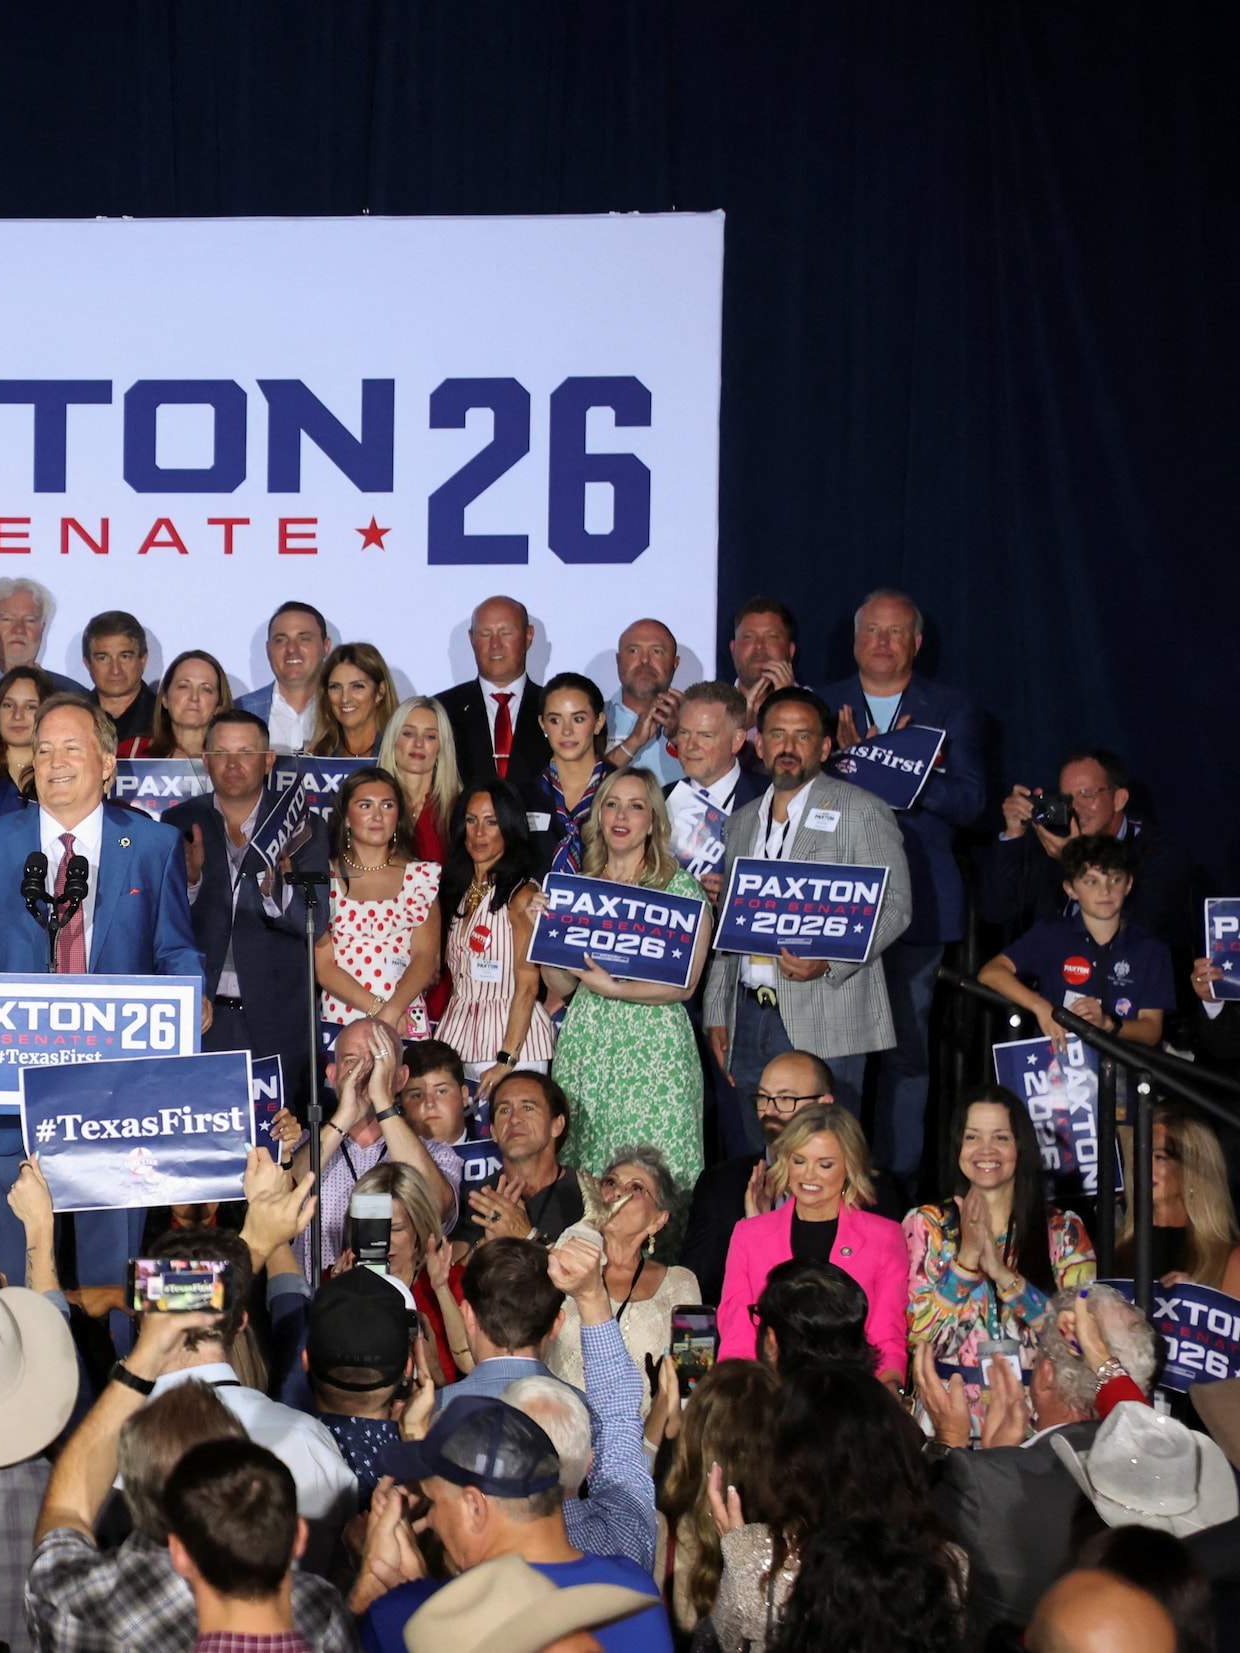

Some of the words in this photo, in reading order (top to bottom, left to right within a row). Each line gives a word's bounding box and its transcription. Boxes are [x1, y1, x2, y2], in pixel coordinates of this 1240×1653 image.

[427, 375, 651, 566] 26
[736, 873, 881, 904] PAXTON
[550, 887, 697, 934] PAXTON
[733, 896, 778, 910] FOR
[787, 899, 874, 916] SENATE
[547, 913, 590, 929] FOR
[601, 920, 691, 943] SENATE
[751, 912, 848, 937] 2026
[563, 926, 666, 959] 2026
[1064, 964, 1090, 974] PAXTON
[1, 1034, 98, 1046] SENATE
[121, 1003, 176, 1050] 26
[36, 1105, 245, 1144] #TexasFirst
[1162, 1322, 1240, 1354] SENAT
